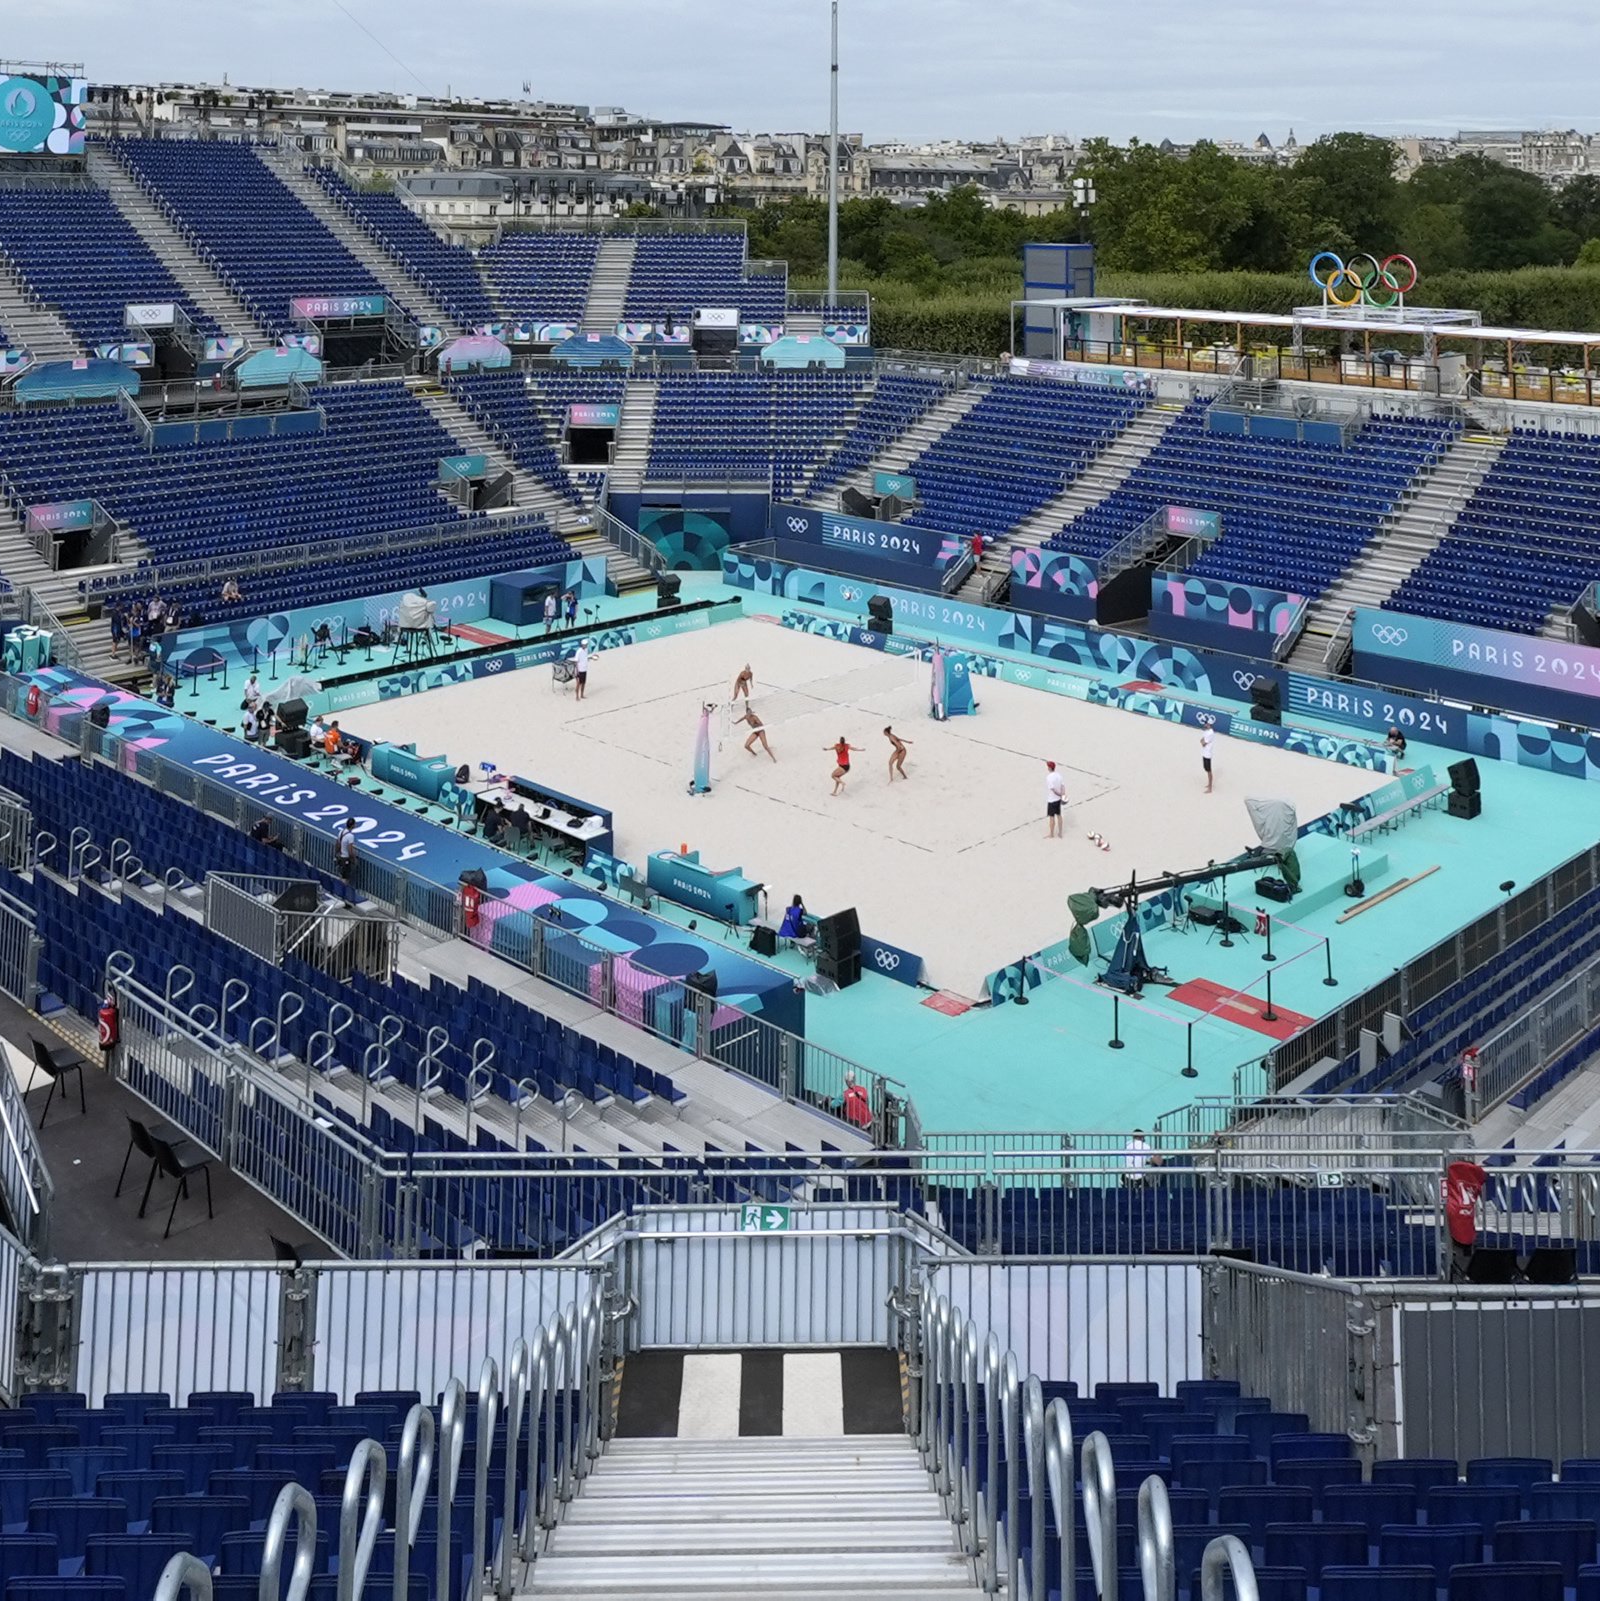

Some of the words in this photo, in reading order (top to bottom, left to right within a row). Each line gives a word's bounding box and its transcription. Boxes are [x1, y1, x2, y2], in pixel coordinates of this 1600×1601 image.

[307, 302, 339, 312] PARIS
[343, 301, 372, 311] 2024
[833, 525, 876, 546] PARIS
[880, 534, 920, 554] 2024
[441, 591, 487, 613] 2024
[889, 596, 935, 620] PARIS
[942, 608, 986, 631] 2024
[1452, 639, 1524, 668] PARIS
[1306, 687, 1374, 718] PARIS
[1383, 704, 1448, 734] 2024
[192, 753, 317, 805] PARIS
[303, 804, 427, 861] 2024
